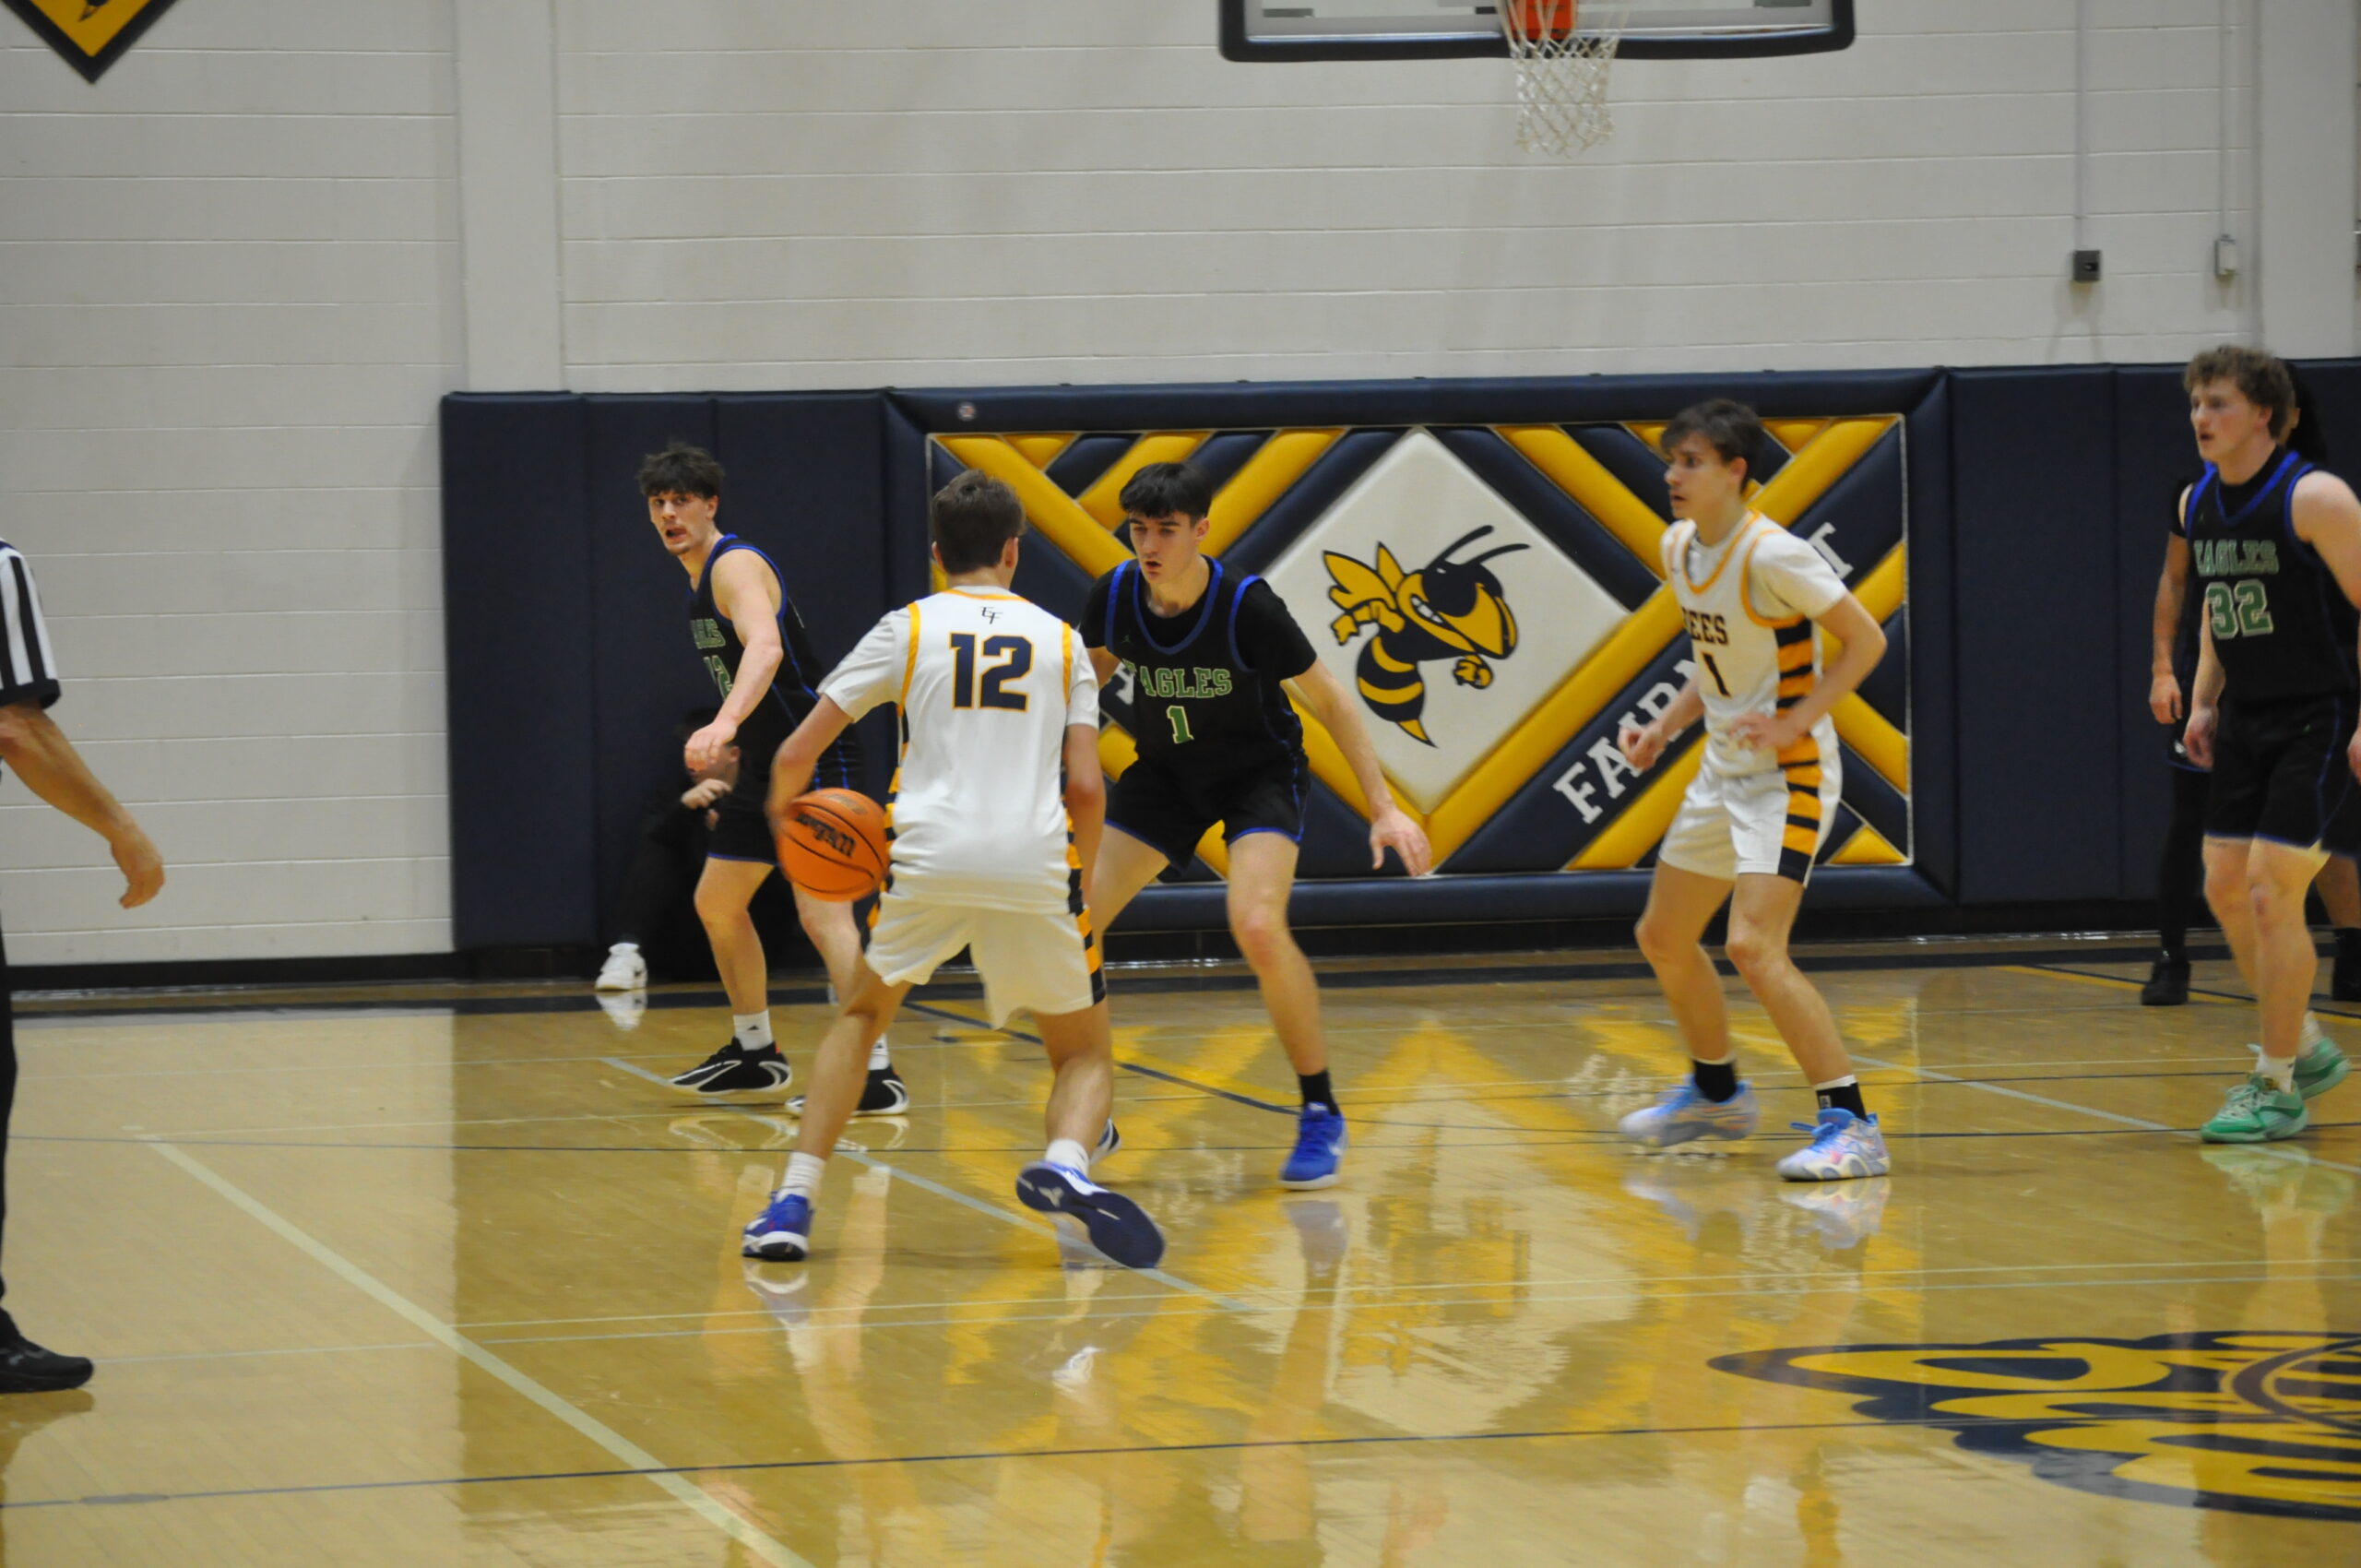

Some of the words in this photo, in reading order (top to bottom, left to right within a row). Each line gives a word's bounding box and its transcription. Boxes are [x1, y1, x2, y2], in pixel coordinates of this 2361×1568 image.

[980, 606, 1003, 624] EF
[1681, 606, 1729, 646] EES
[2205, 578, 2274, 640] 32
[948, 632, 1034, 713] 12
[1700, 650, 1732, 698] 1
[1166, 705, 1194, 744] 1
